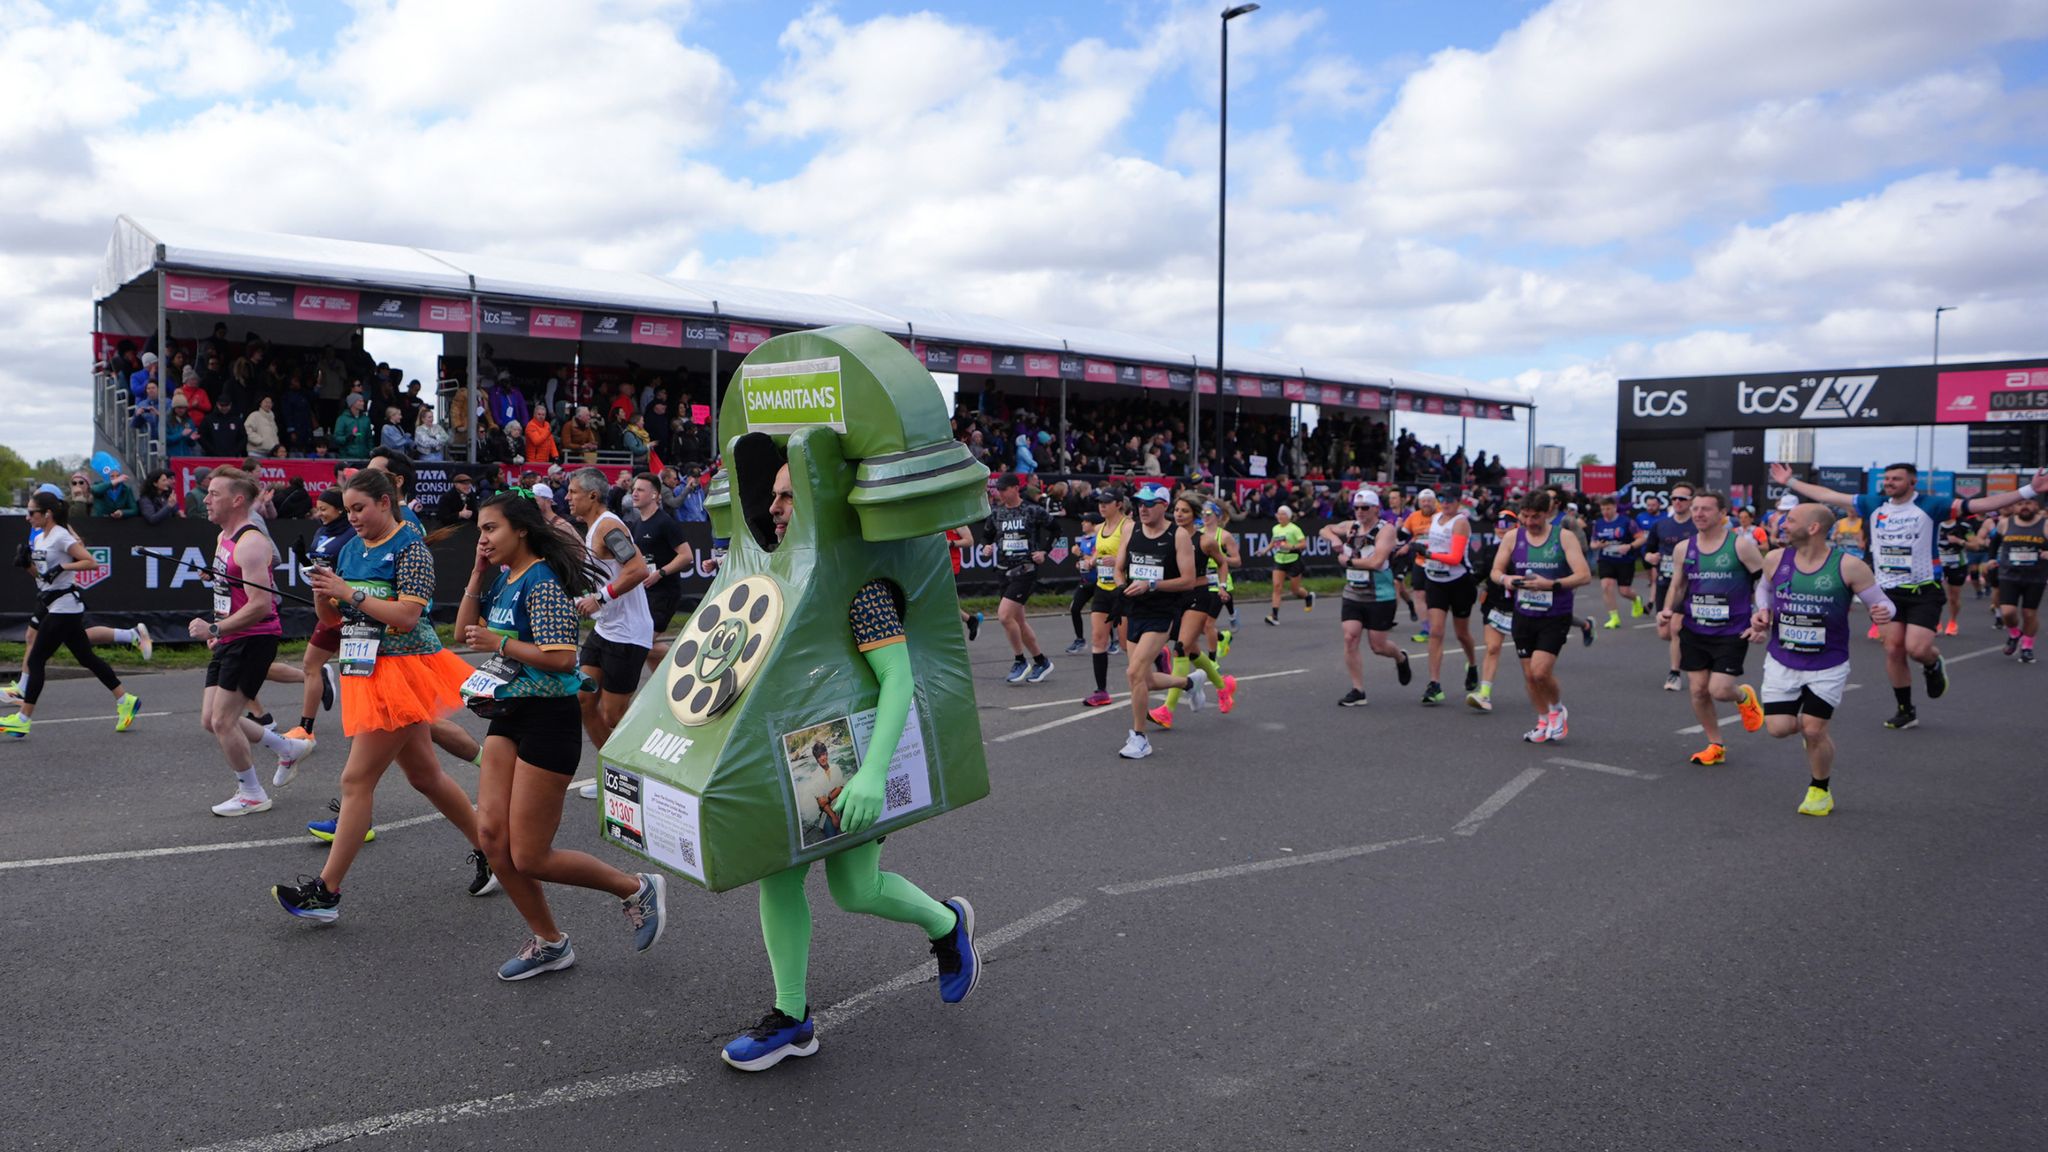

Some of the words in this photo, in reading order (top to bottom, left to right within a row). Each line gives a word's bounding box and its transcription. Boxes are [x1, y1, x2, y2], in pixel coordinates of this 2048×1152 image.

[234, 290, 256, 305] tcs
[747, 386, 836, 411] SAMARITANS
[1633, 385, 1688, 417] tcs
[1738, 380, 1799, 414] tcs
[1800, 378, 1816, 388] 20
[1861, 407, 1879, 418] 24
[415, 470, 447, 480] TATA
[1632, 468, 1688, 477] CONSULTANCY
[1821, 470, 1847, 481] Lingo
[1632, 476, 1667, 484] SERVICES
[415, 494, 442, 505] SERV
[1631, 486, 1670, 510] tcs
[1002, 519, 1025, 531] PAUL
[1134, 567, 1158, 577] 45714
[1687, 571, 1732, 580] DACORUM
[1775, 591, 1834, 603] DACORUM
[1782, 602, 1823, 614] MIKEY
[1784, 627, 1818, 641] 49072
[640, 727, 694, 765] DAVE
[605, 769, 619, 790] tcs
[609, 798, 634, 825] 31307
